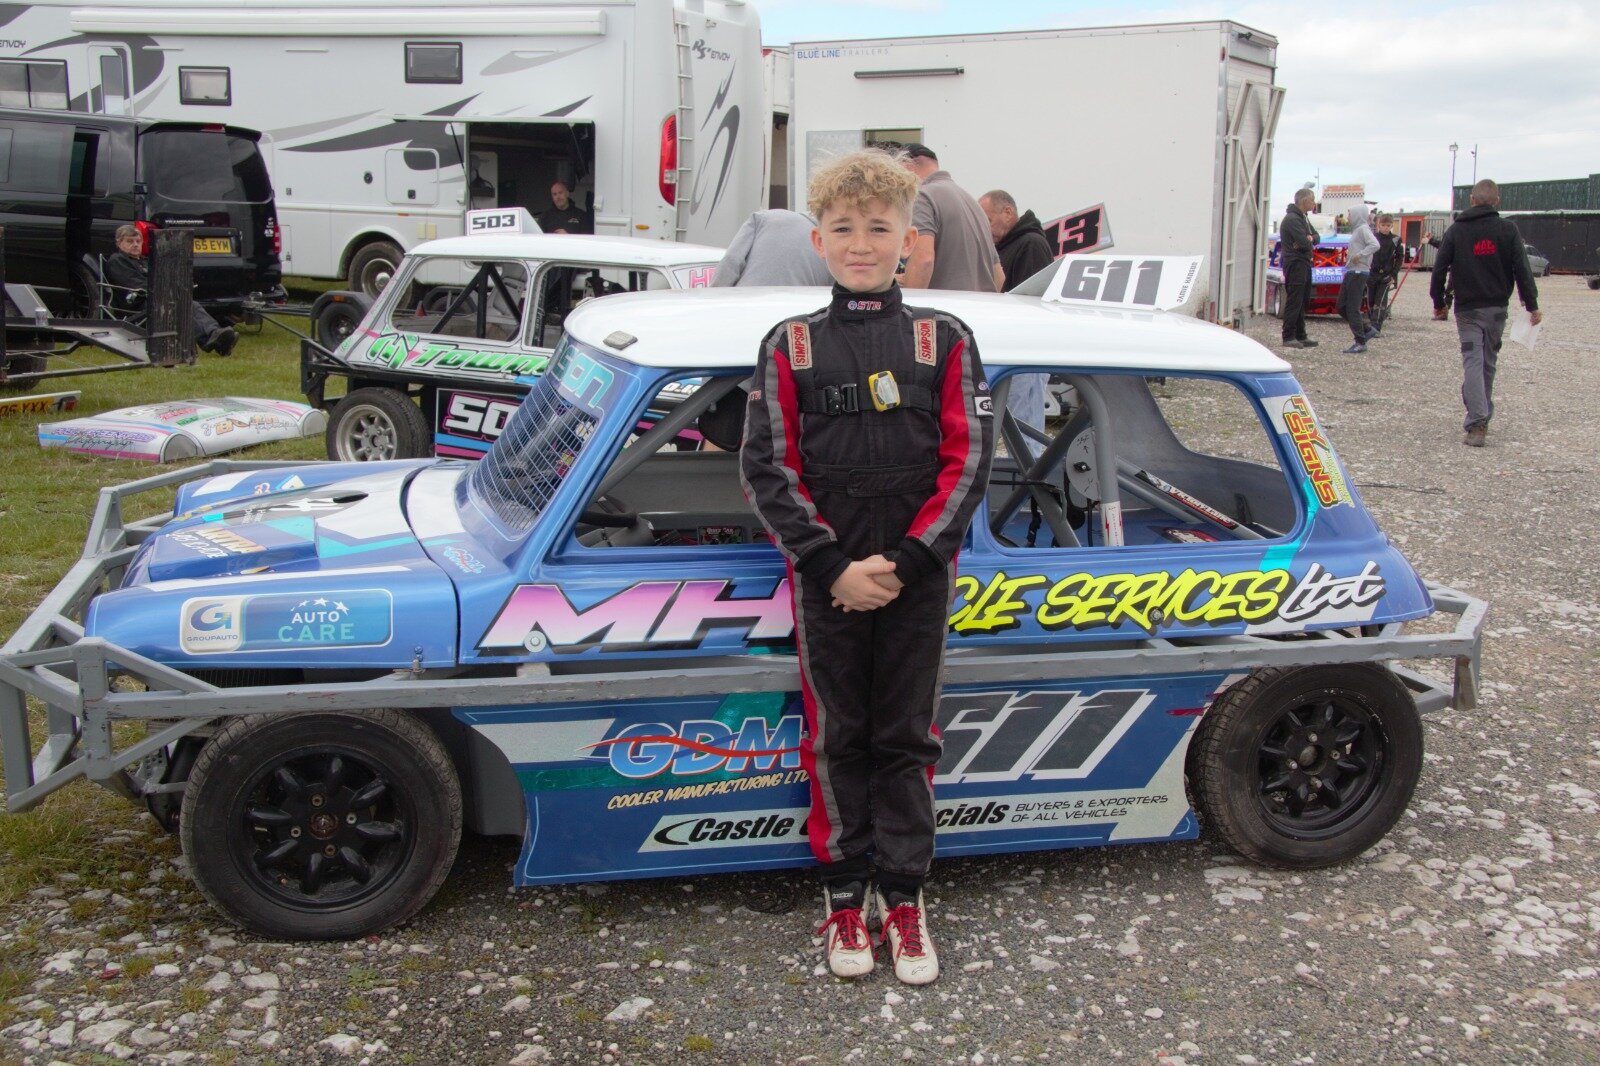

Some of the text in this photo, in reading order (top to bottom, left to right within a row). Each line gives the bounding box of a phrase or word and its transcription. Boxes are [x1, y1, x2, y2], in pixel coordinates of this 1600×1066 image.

[797, 48, 889, 59] BLUE LINE TRAILERS
[472, 214, 515, 230] 503
[1315, 268, 1343, 276] M&E
[1061, 260, 1164, 305] 611
[857, 301, 881, 310] STR
[791, 324, 806, 364] SIMPSON
[921, 322, 932, 360] SIMPSON
[1284, 412, 1339, 506] SIGNS
[1037, 568, 1290, 630] SERVICES
[1278, 560, 1384, 620] Ltd
[291, 610, 340, 624] AUTO
[187, 634, 238, 642] GROUPAUTO
[278, 623, 355, 643] CARE
[608, 714, 804, 779] GDM
[607, 788, 662, 810] COOLER
[664, 771, 783, 803] MANUFACTURING
[1015, 795, 1169, 812] BUYERS & EXPORTERS
[1011, 808, 1128, 823] OF ALL VEHICLES
[688, 814, 795, 843] Castle
